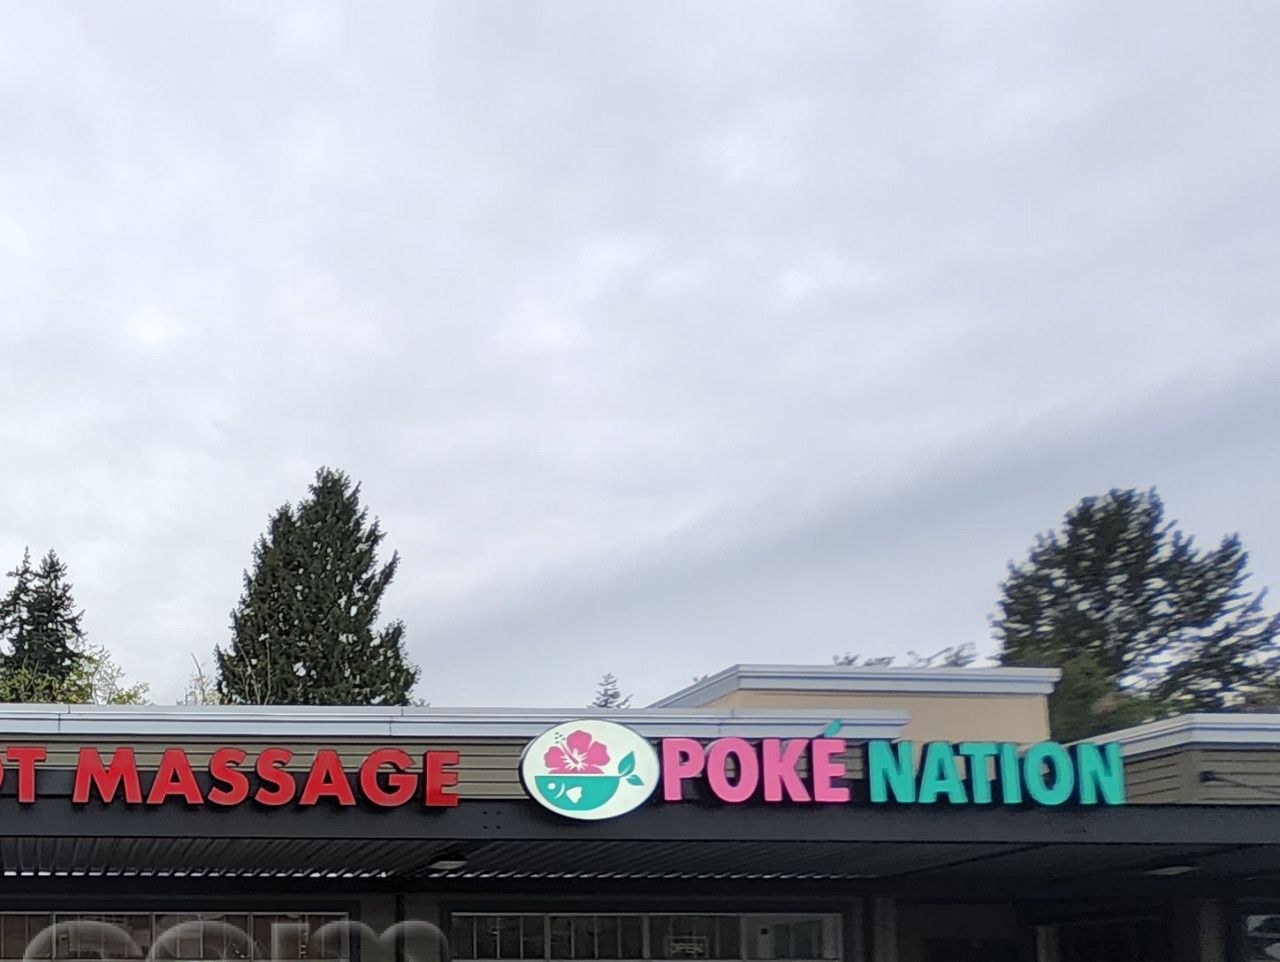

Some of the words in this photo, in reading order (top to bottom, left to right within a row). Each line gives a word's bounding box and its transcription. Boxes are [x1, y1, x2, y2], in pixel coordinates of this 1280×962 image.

[72, 746, 461, 808] MASSAGE
[662, 719, 852, 803] POKÉ
[868, 740, 1126, 807] NATION
